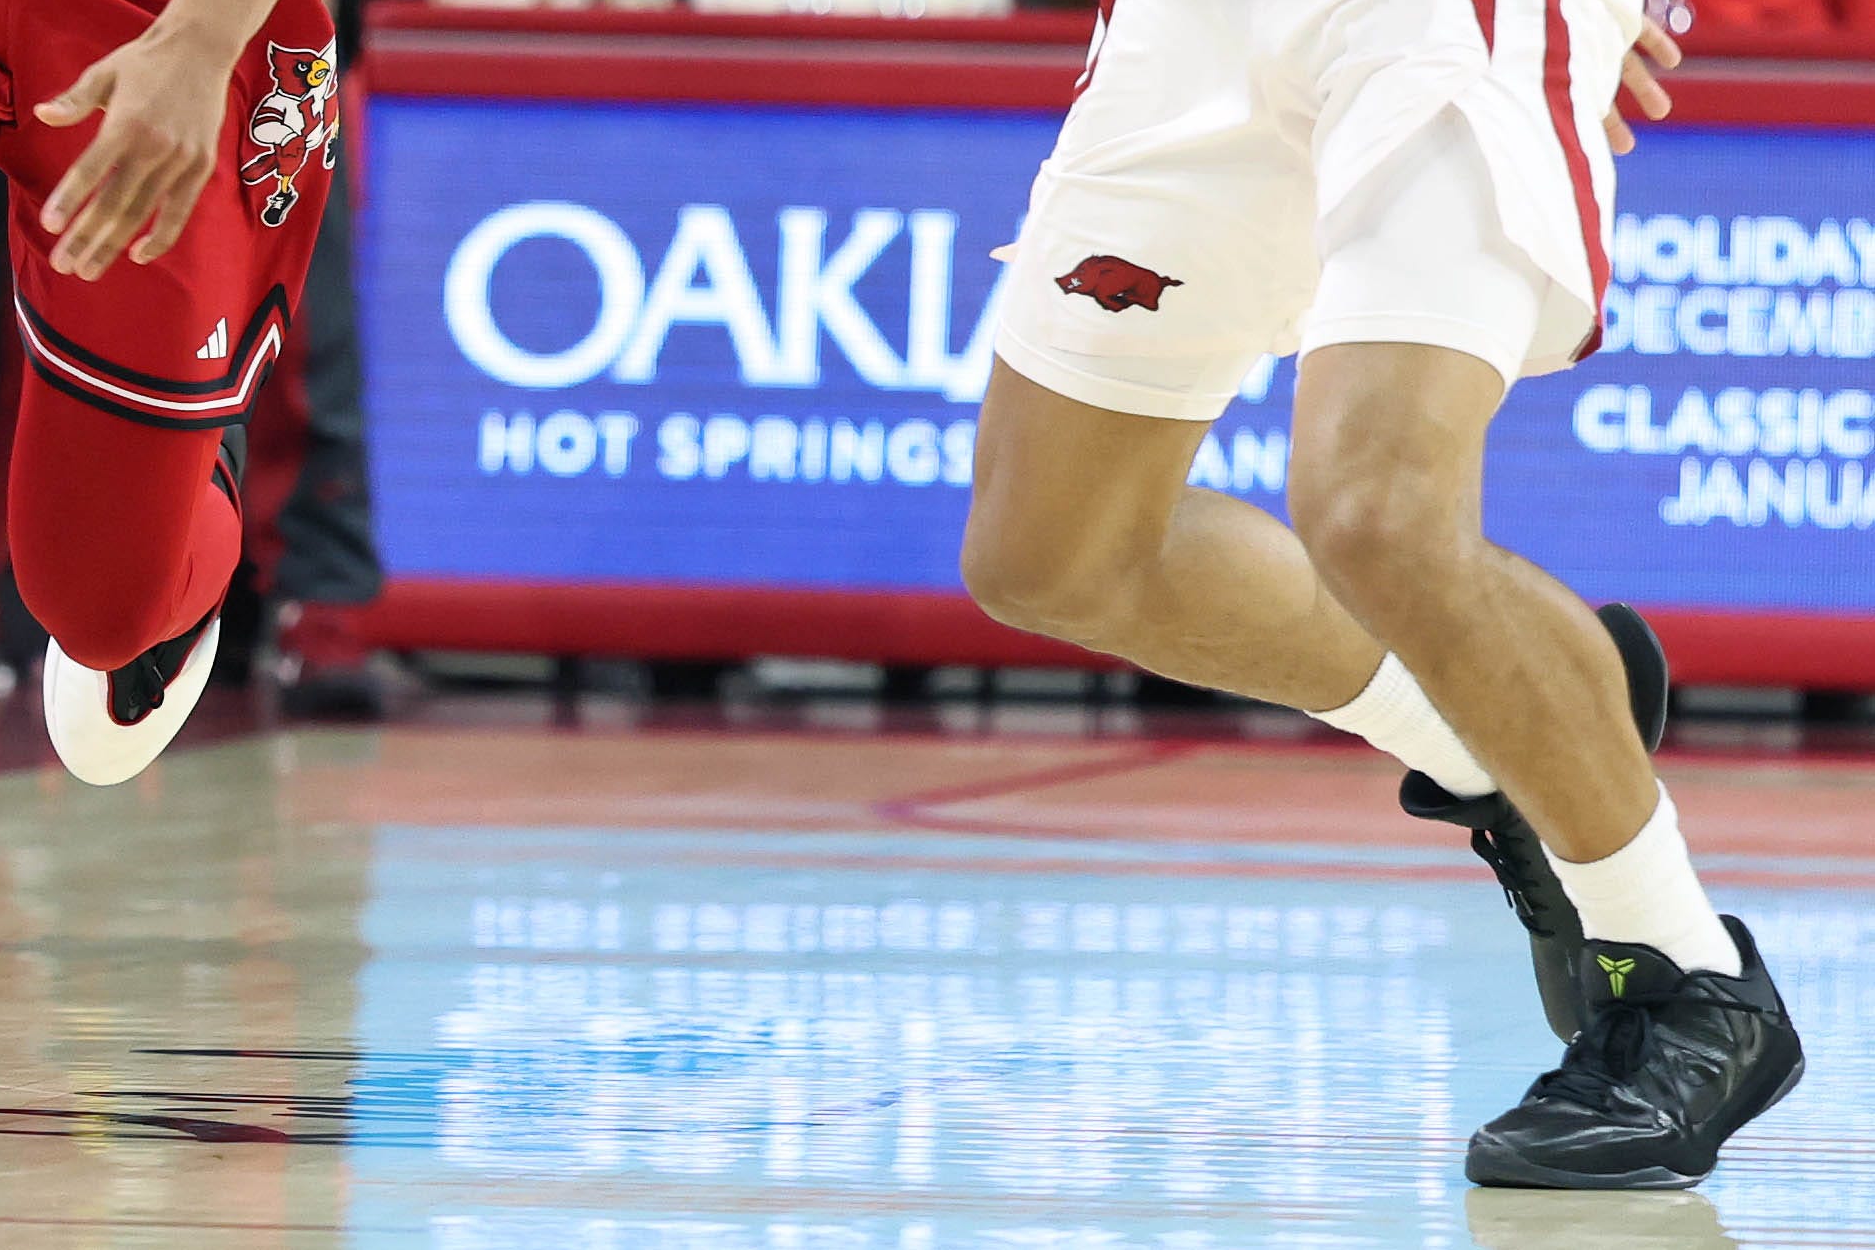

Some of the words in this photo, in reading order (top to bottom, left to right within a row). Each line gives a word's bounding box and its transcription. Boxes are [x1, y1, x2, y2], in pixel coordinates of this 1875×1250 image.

[478, 408, 639, 477] HOT
[657, 411, 975, 487] SPRINGS
[1573, 384, 1875, 459] CLASSIC
